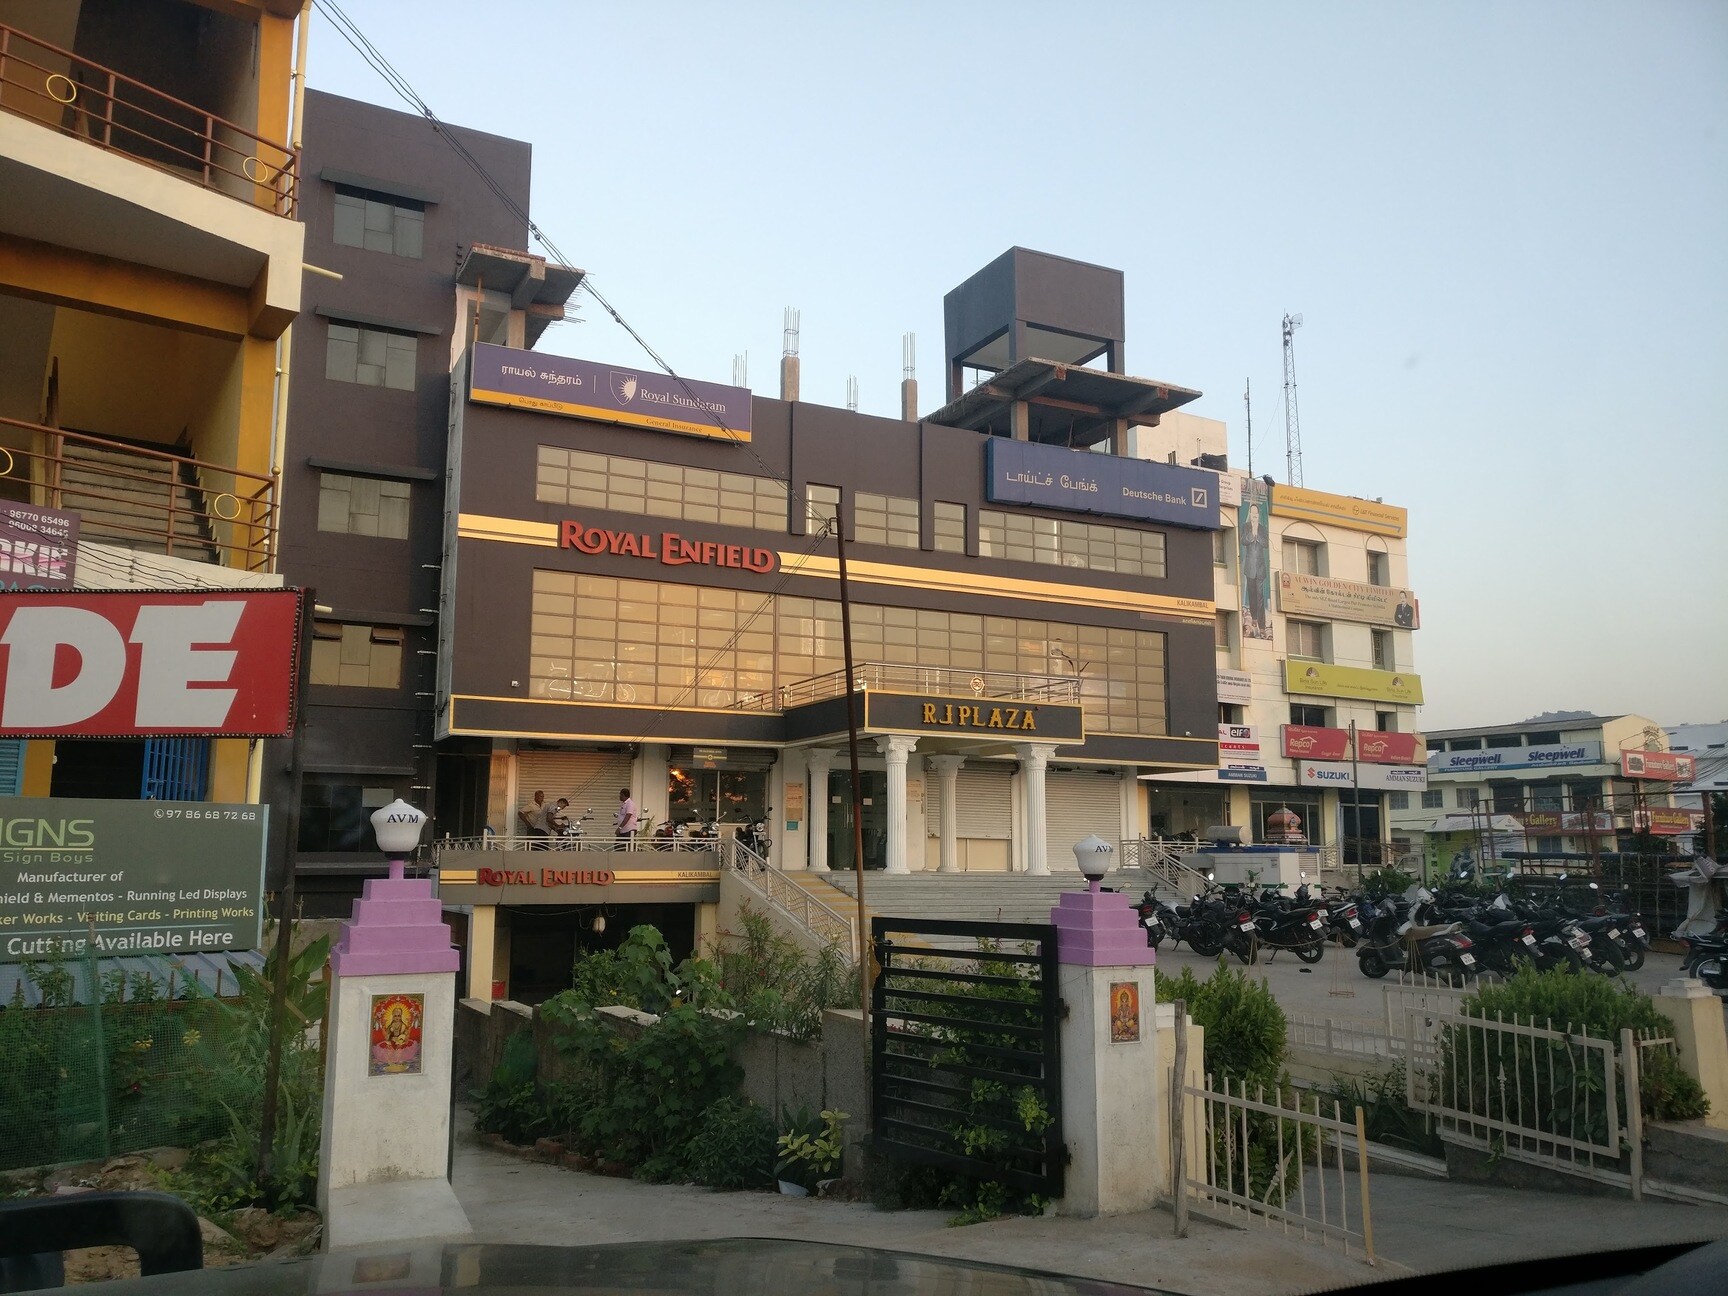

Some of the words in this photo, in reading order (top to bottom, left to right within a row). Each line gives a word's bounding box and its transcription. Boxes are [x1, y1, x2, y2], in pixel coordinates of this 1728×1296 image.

[501, 365, 536, 378] ராயல்
[540, 370, 582, 386] சுந்தரம்
[641, 388, 669, 403] Royal
[673, 394, 726, 412] Sundaram
[646, 418, 671, 427] General
[672, 422, 702, 433] Insurance
[1006, 470, 1053, 486] டாய்ட்ச்
[1060, 474, 1098, 492] பேங்க்
[1123, 487, 1163, 501] Deutsche
[1165, 494, 1187, 506] Bank
[560, 520, 657, 559] ROYAL
[661, 532, 775, 573] ENFIELD
[958, 705, 1037, 730] PLAZA
[1289, 738, 1310, 750] Repco
[1363, 743, 1382, 753] Repco
[1450, 753, 1502, 767] Sleepwell
[1528, 748, 1585, 762] Sleepwell
[1316, 770, 1350, 780] SUZUKI
[387, 813, 419, 823] AVM
[4, 852, 42, 864] Sign
[50, 853, 94, 864] Boys
[17, 871, 107, 883] Manufacturer
[110, 871, 124, 882] of
[478, 867, 538, 887] ROYAL
[541, 867, 615, 888] ENFIELD
[34, 892, 44, 904] &
[48, 892, 114, 903] Mementos
[127, 890, 176, 902] Running
[179, 889, 200, 900] Led
[203, 888, 248, 901] Displays
[23, 913, 63, 924] Works
[77, 910, 124, 924] Viiting
[128, 909, 161, 921] Cards
[173, 908, 218, 920] Printing
[221, 907, 255, 918] Works
[95, 930, 183, 951] Available
[189, 930, 234, 946] Here
